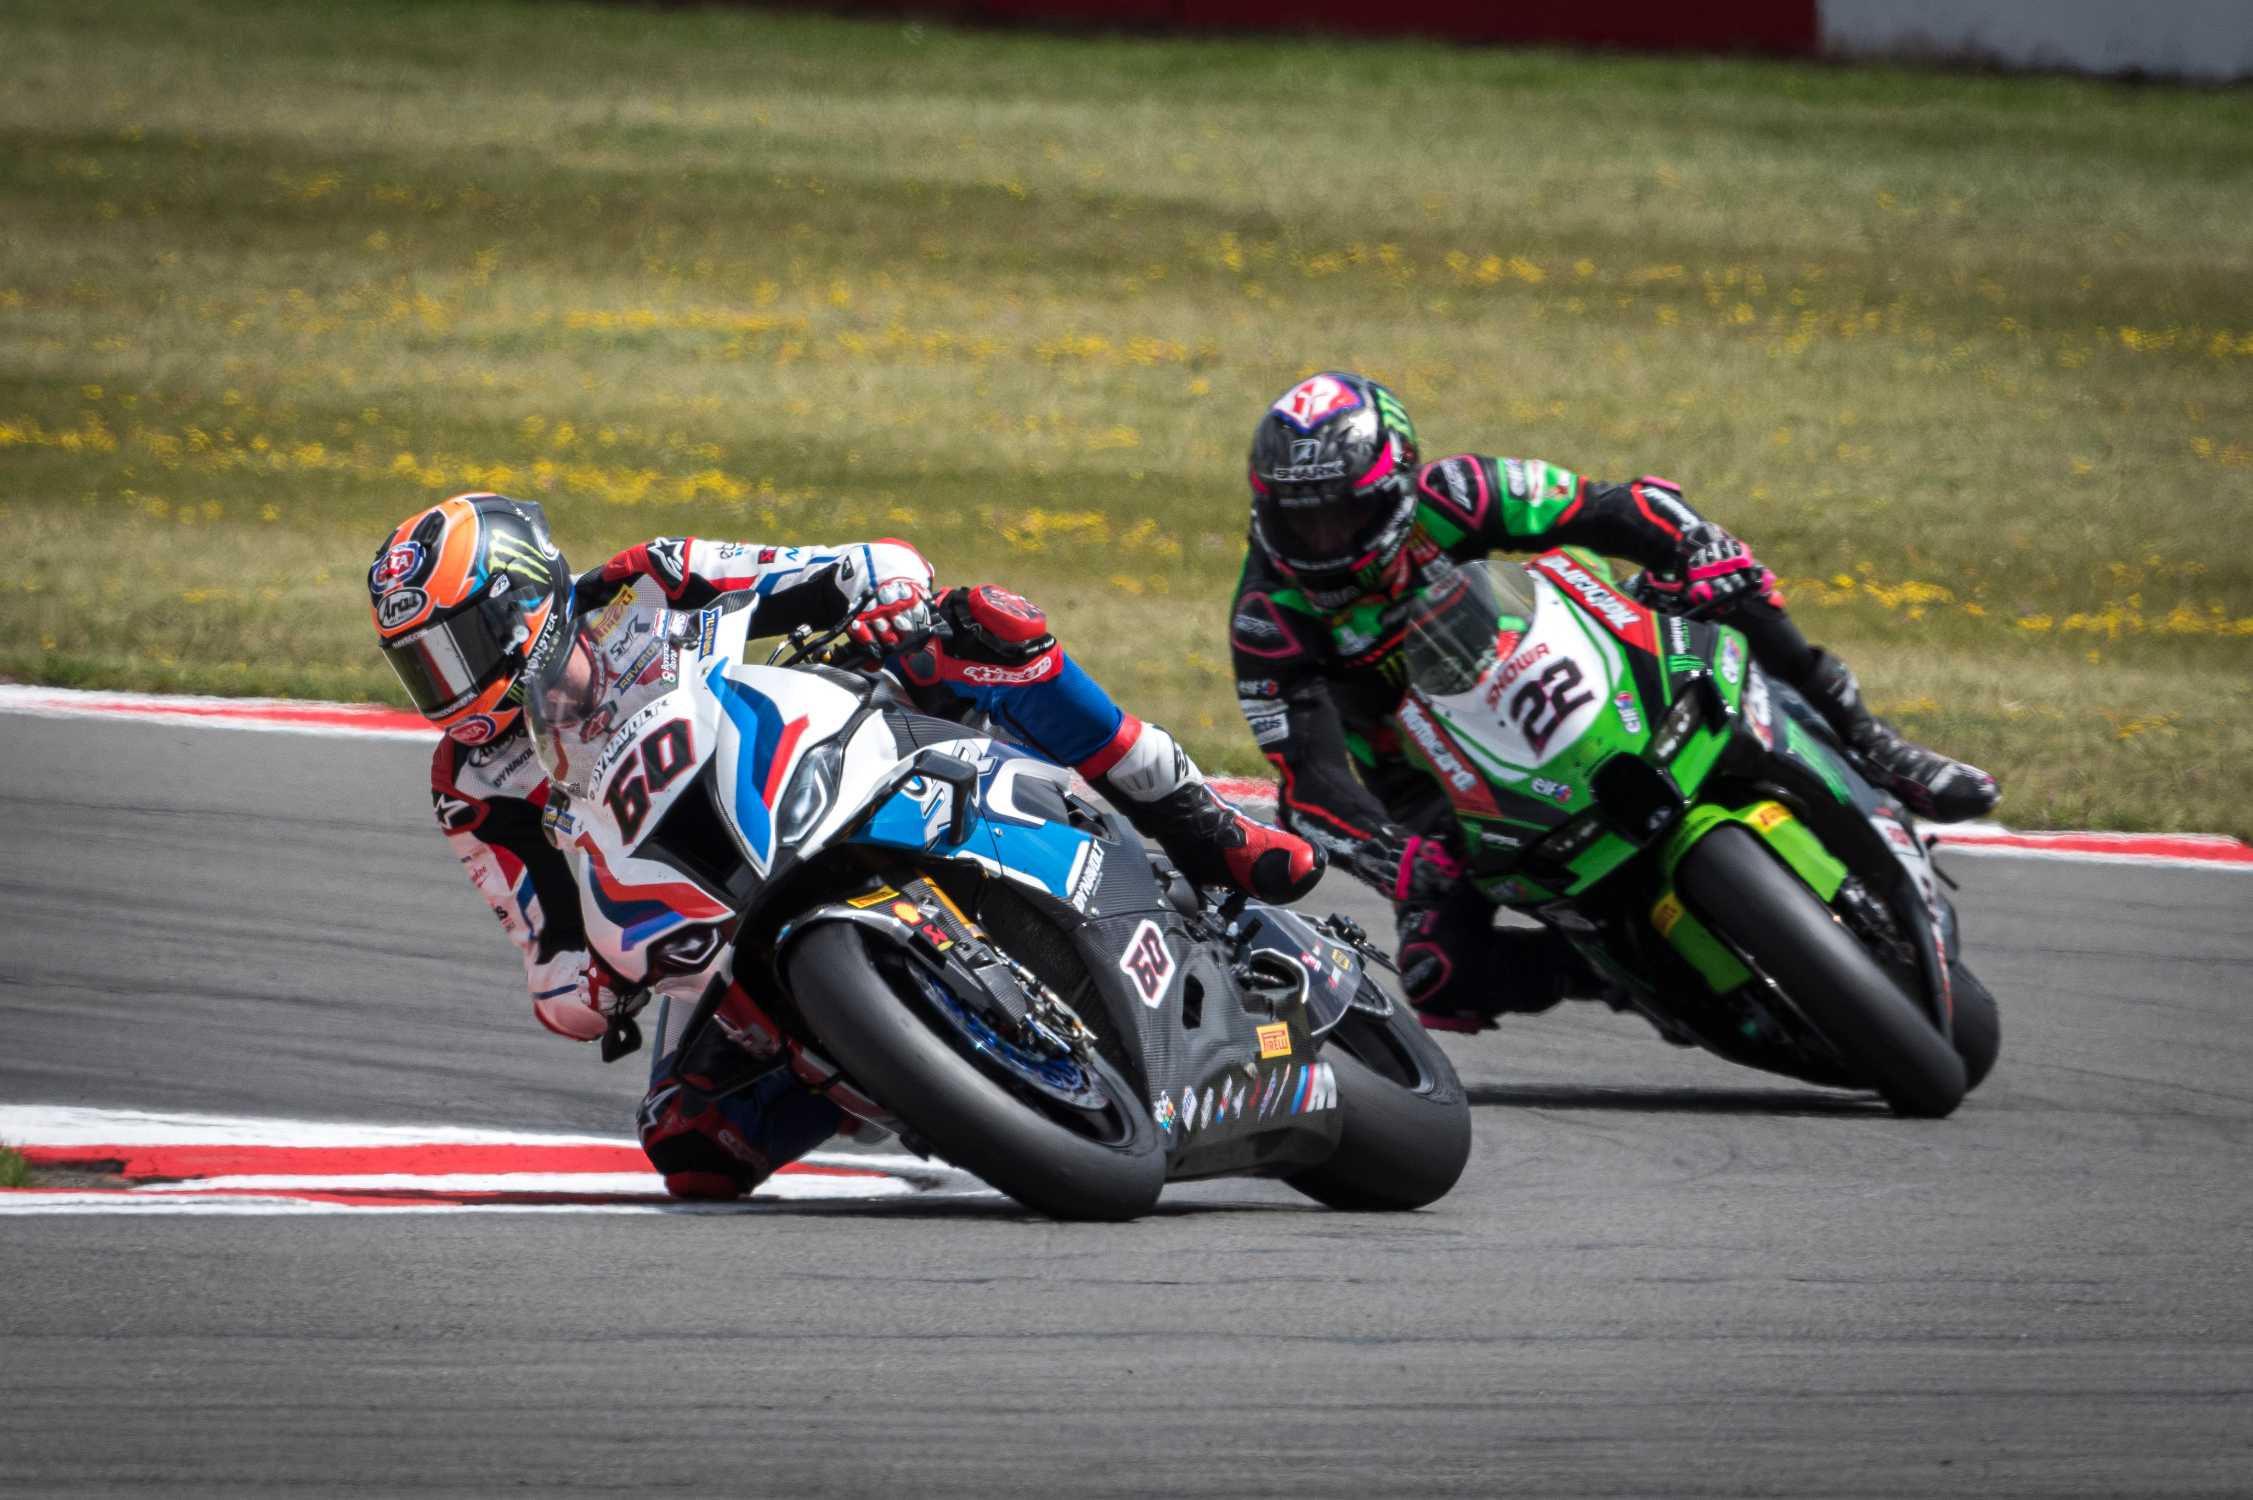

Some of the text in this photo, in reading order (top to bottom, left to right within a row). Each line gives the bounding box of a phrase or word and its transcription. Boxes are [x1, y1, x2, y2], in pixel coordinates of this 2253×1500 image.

[1510, 656, 1596, 759] 22
[602, 716, 698, 845] 60
[1126, 926, 1170, 1001] 60
[1261, 1030, 1289, 1051] PIRELLI
